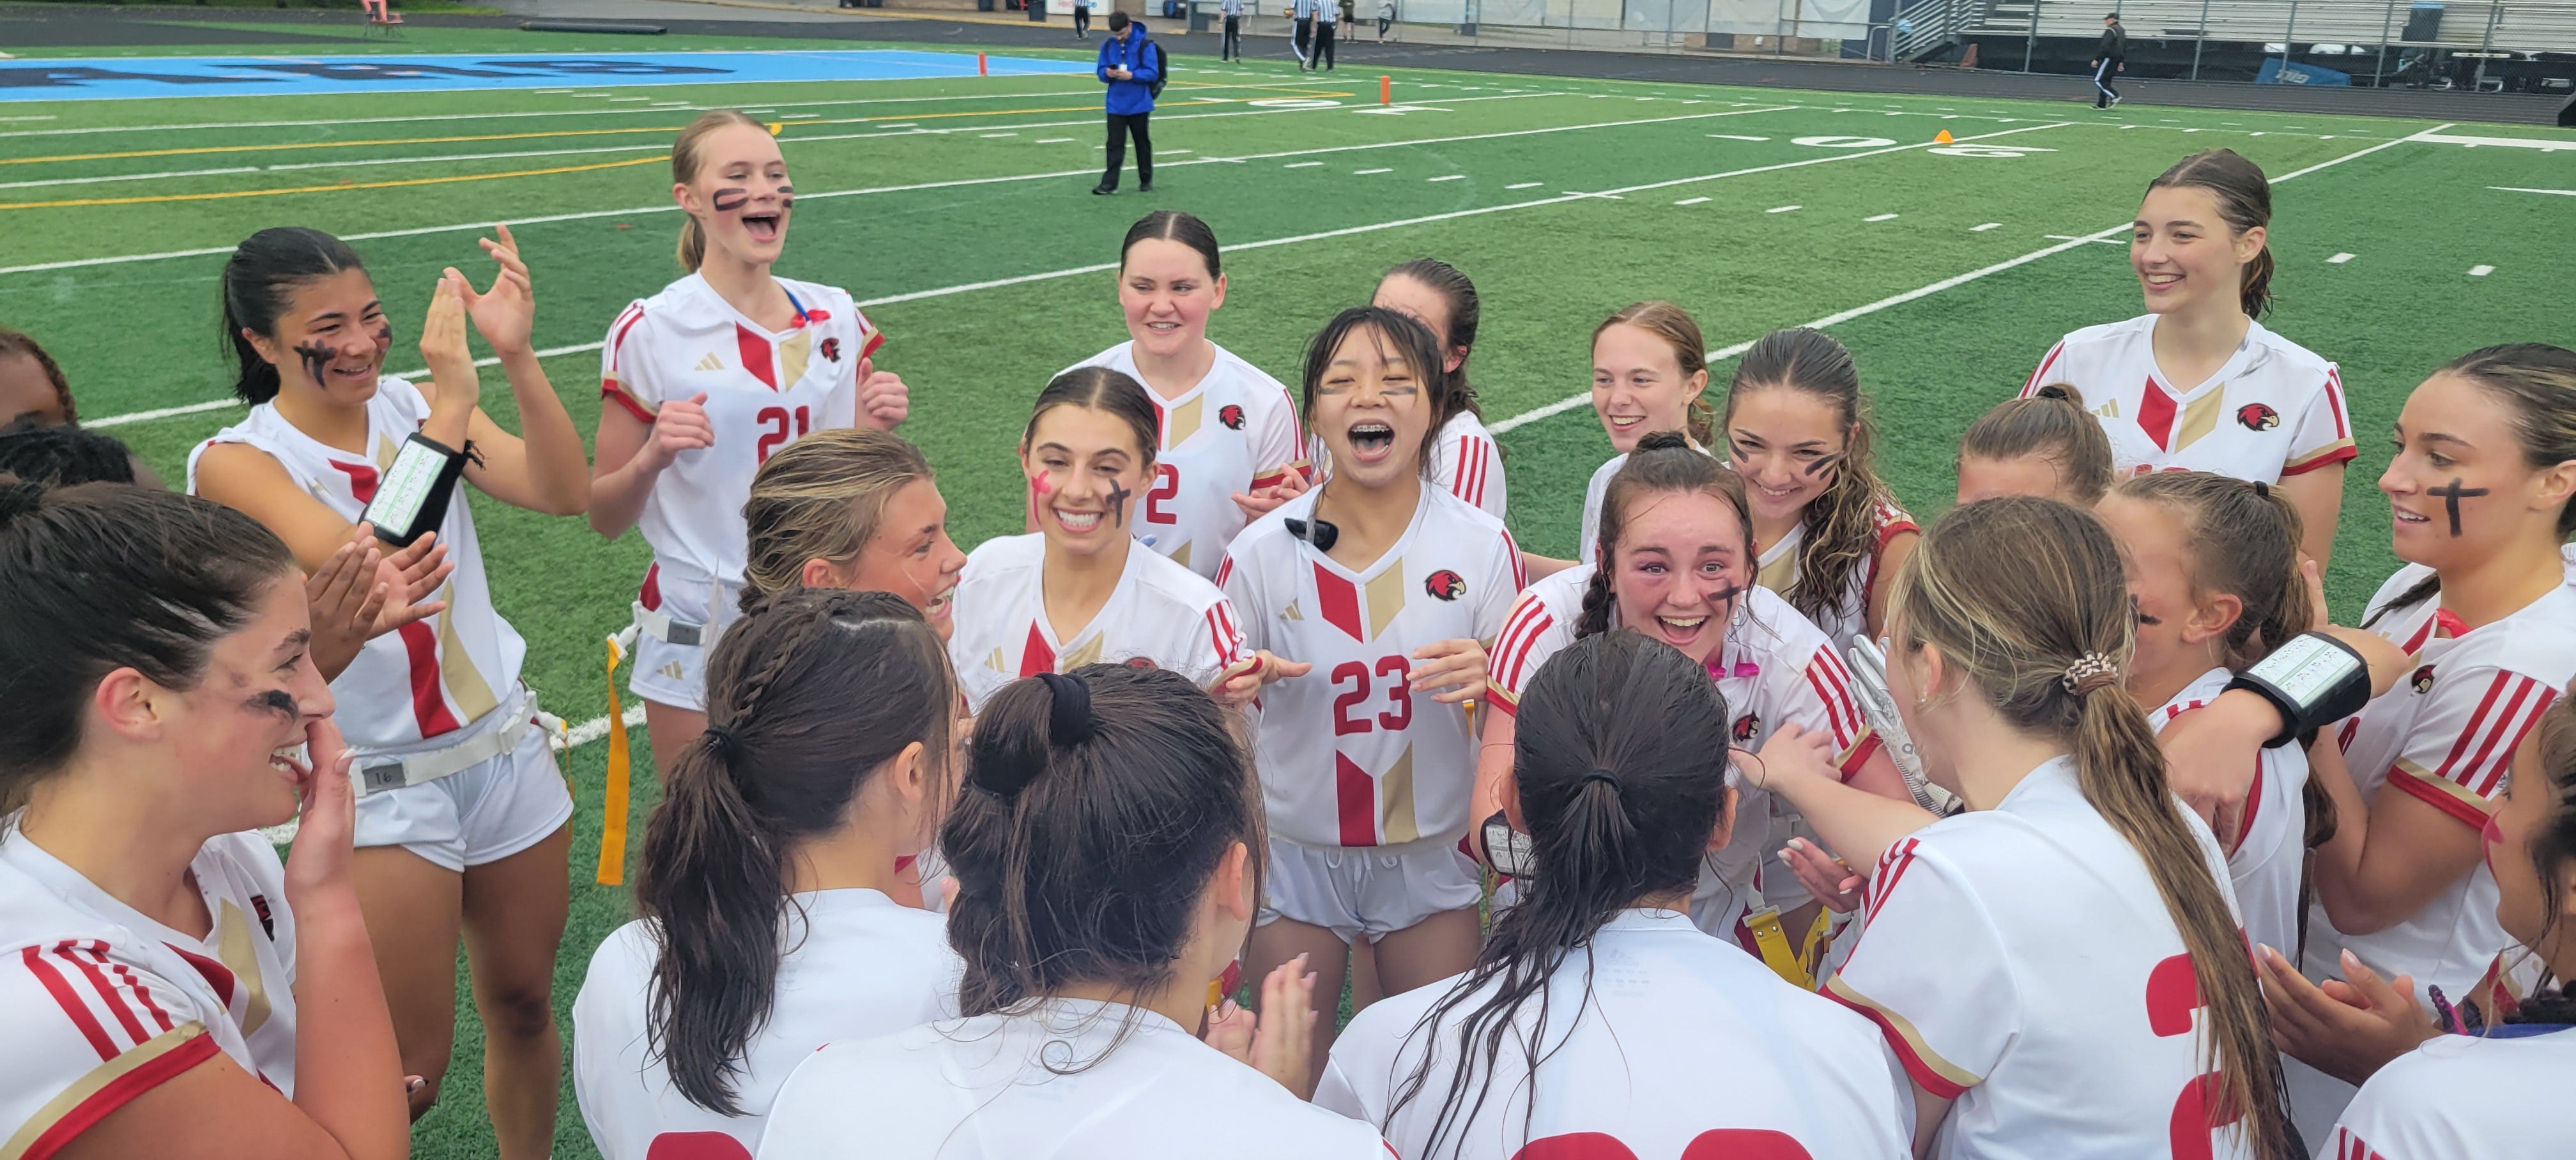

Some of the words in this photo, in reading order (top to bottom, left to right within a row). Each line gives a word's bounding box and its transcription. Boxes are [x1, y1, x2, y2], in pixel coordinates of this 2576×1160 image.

[756, 405, 810, 467] 21
[1146, 463, 1180, 525] 2
[1331, 654, 1413, 736] 23
